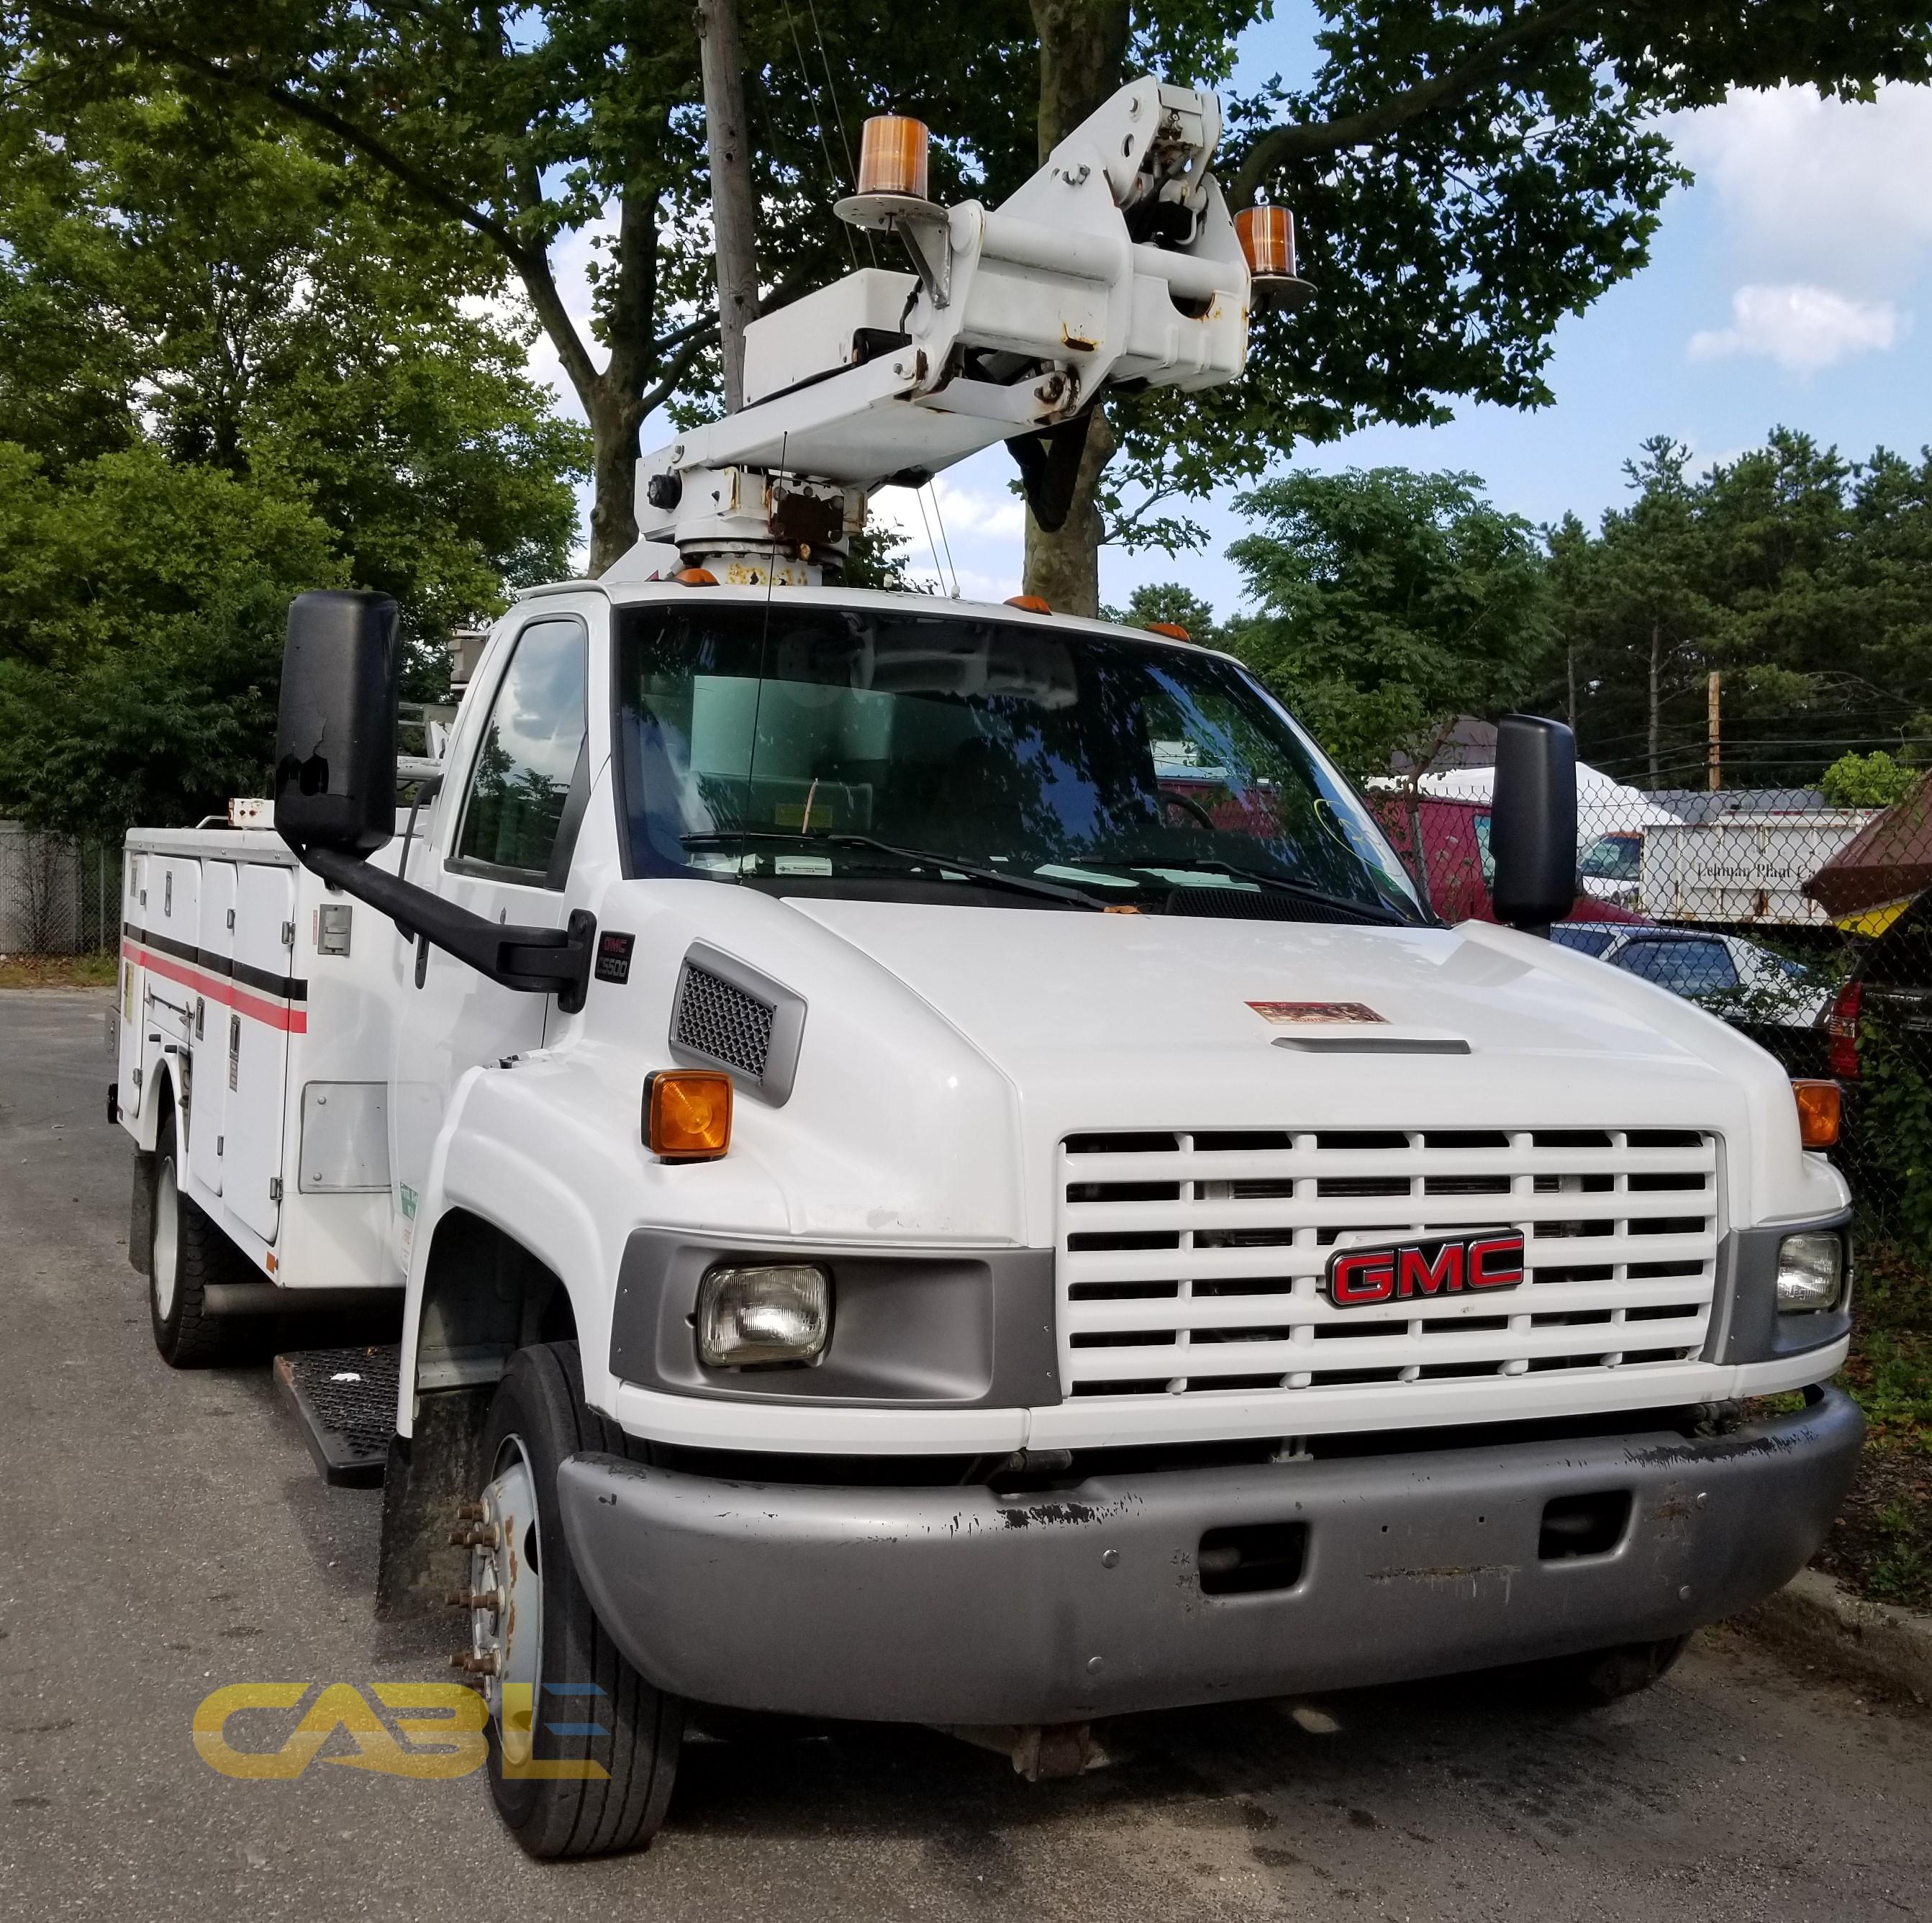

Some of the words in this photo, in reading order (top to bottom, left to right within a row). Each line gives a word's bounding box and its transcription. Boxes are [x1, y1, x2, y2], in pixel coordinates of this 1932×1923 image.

[1698, 863, 1750, 877] Lehman
[1756, 864, 1790, 878] Plant
[604, 936, 627, 954] GMC
[1333, 1234, 1523, 1305] GMC
